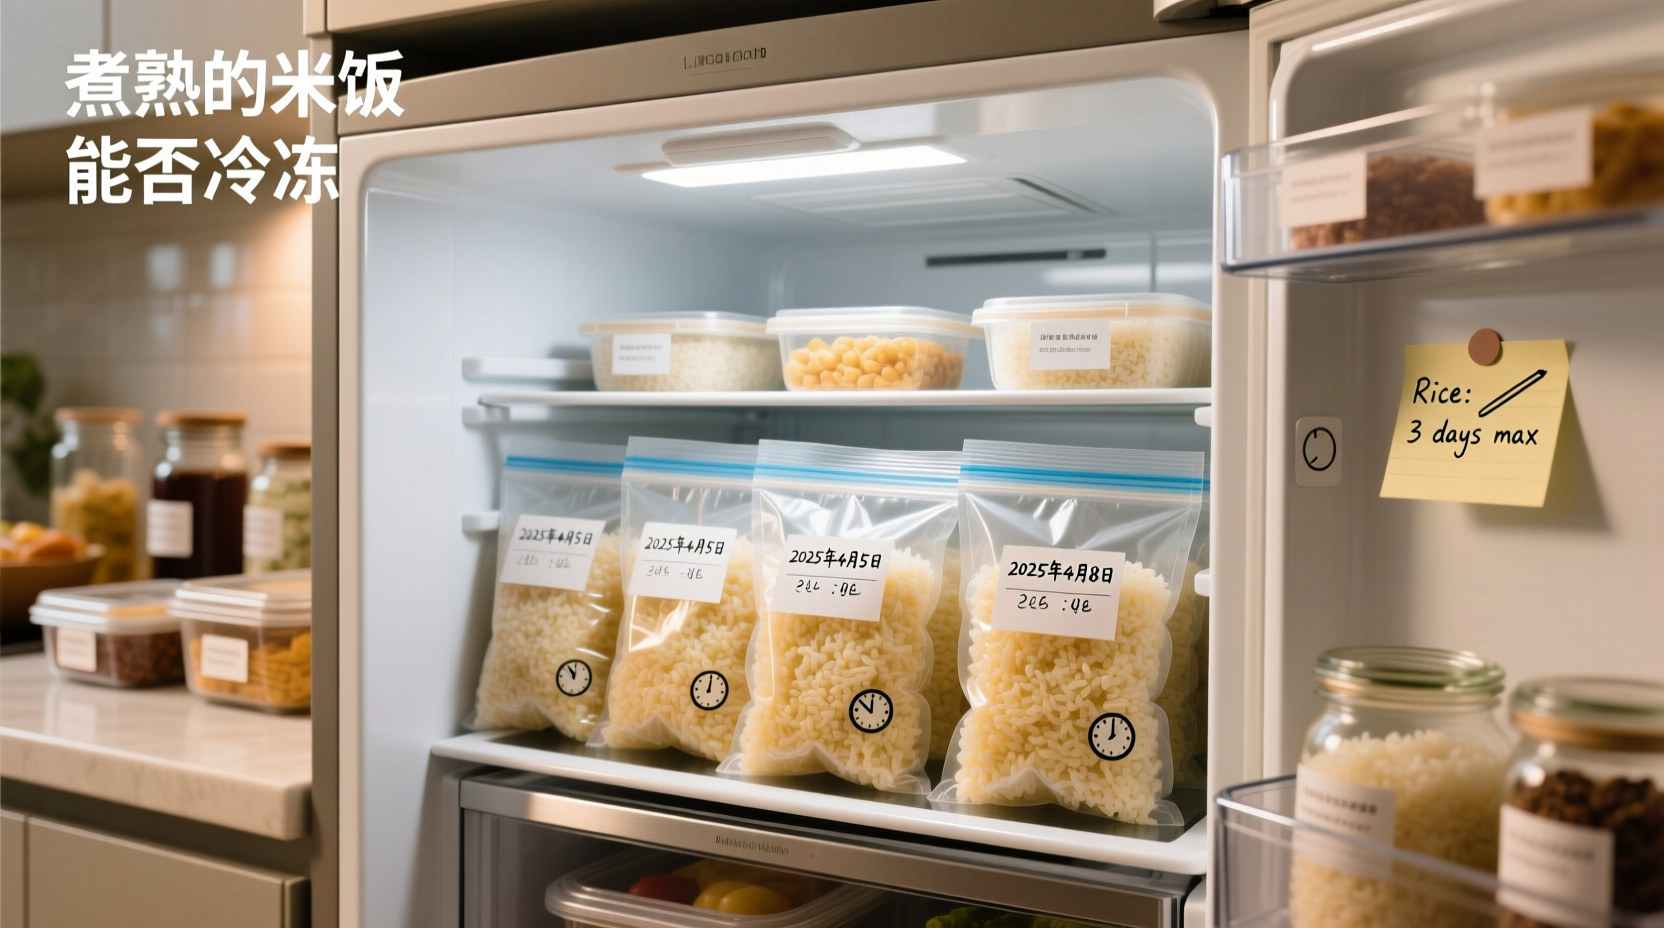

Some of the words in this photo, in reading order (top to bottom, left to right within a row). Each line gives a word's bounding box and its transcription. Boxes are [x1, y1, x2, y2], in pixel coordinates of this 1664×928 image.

[1413, 376, 1471, 404] Rice:
[1407, 419, 1422, 444] 3
[1432, 418, 1482, 459] days
[1493, 428, 1539, 446] max
[644, 535, 725, 555] 2025年4月5日
[789, 547, 882, 569] 2025年4月5日
[1008, 559, 1114, 584] 2025年4月8日
